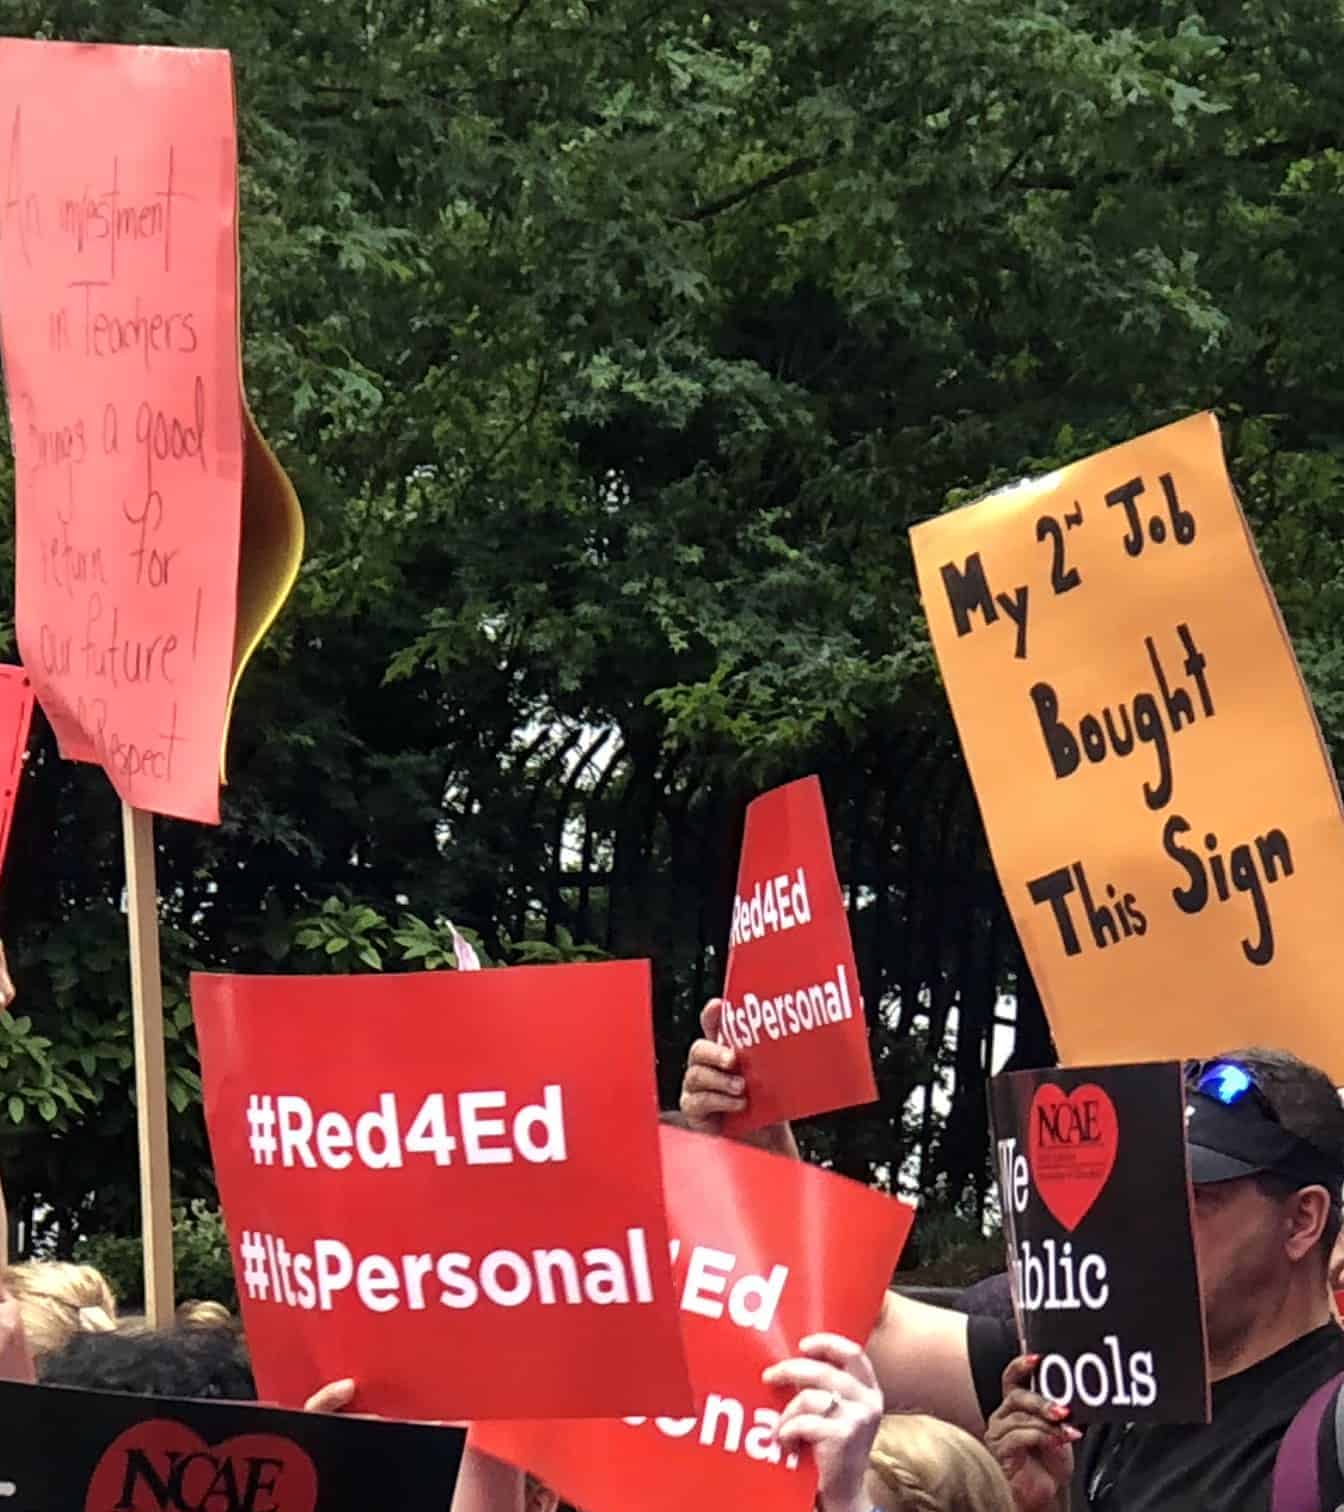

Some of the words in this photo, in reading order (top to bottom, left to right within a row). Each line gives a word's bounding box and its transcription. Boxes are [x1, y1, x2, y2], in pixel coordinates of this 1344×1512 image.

[104, 403, 119, 454] a
[122, 375, 207, 524] good
[128, 489, 183, 588] for
[939, 552, 1029, 658] My
[1105, 472, 1195, 556] Job
[1029, 623, 1216, 810] Bought
[731, 866, 811, 947] Red4Ed
[1026, 861, 1148, 957] This
[1163, 814, 1295, 966] Sign
[720, 963, 853, 1050] ItsPersonal
[246, 1085, 567, 1169] #Red4Ed
[1037, 1100, 1102, 1147] NCAE
[240, 1228, 653, 1312] #ItsPersonal
[1039, 1335, 1157, 1407] ools
